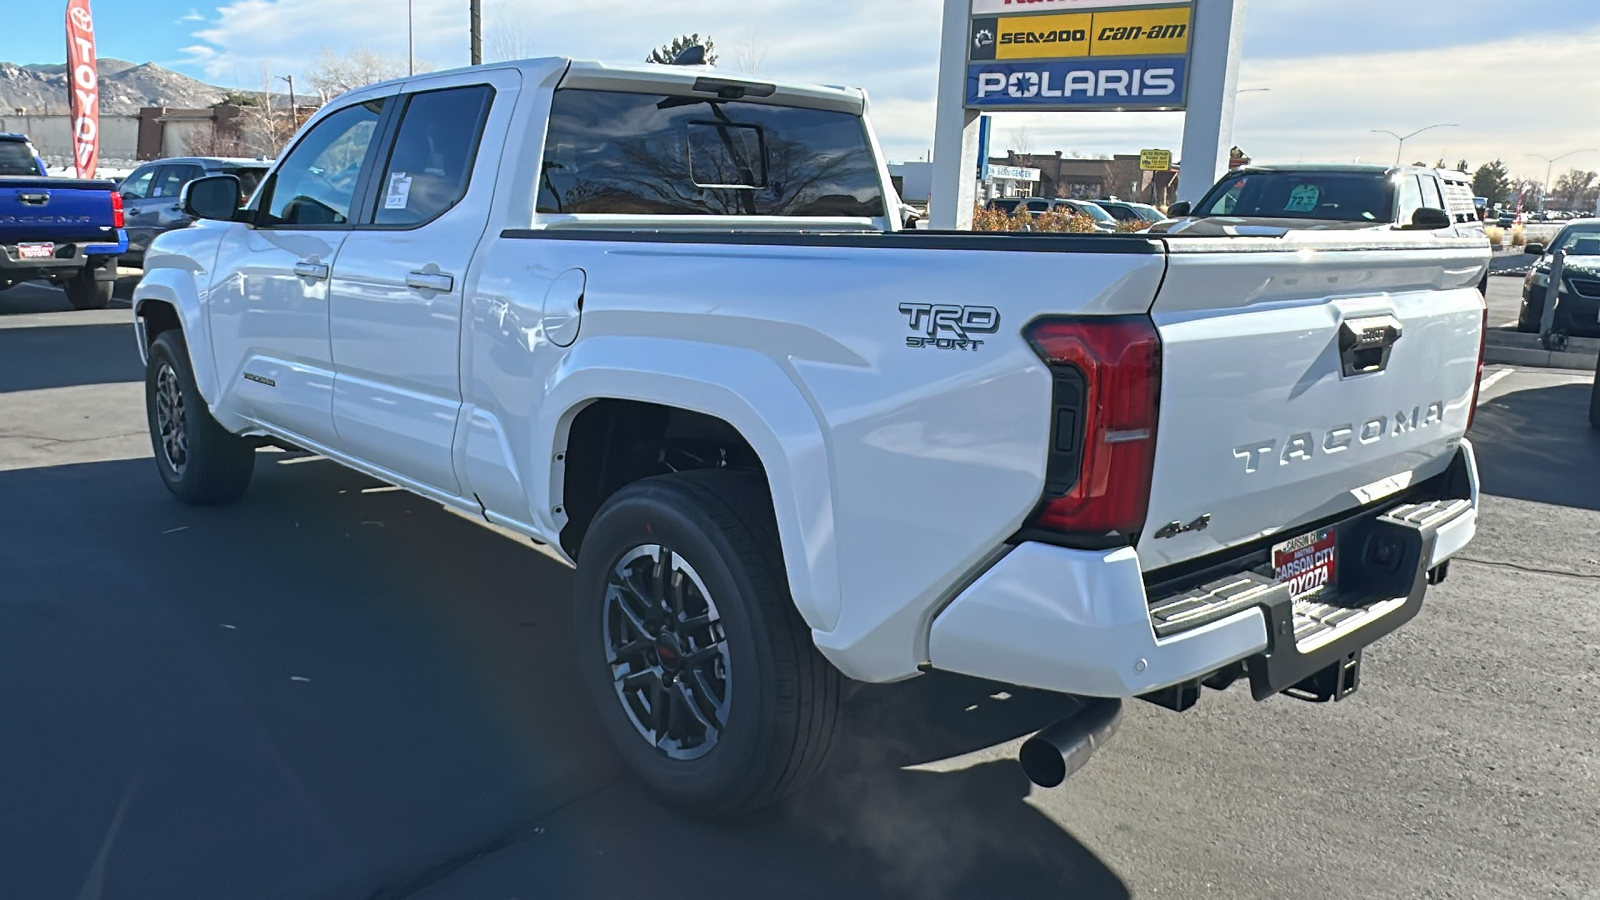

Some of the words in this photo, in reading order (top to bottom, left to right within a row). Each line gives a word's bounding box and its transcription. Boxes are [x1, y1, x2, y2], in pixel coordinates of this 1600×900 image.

[1098, 24, 1185, 42] can-am
[977, 68, 1176, 98] POLARIS
[75, 36, 96, 178] TOYOT
[898, 302, 1001, 339] TRD
[906, 337, 985, 351] SPORT
[1233, 400, 1444, 473] TACOMA
[1275, 554, 1314, 580] CARSON
[1315, 546, 1335, 566] CITY
